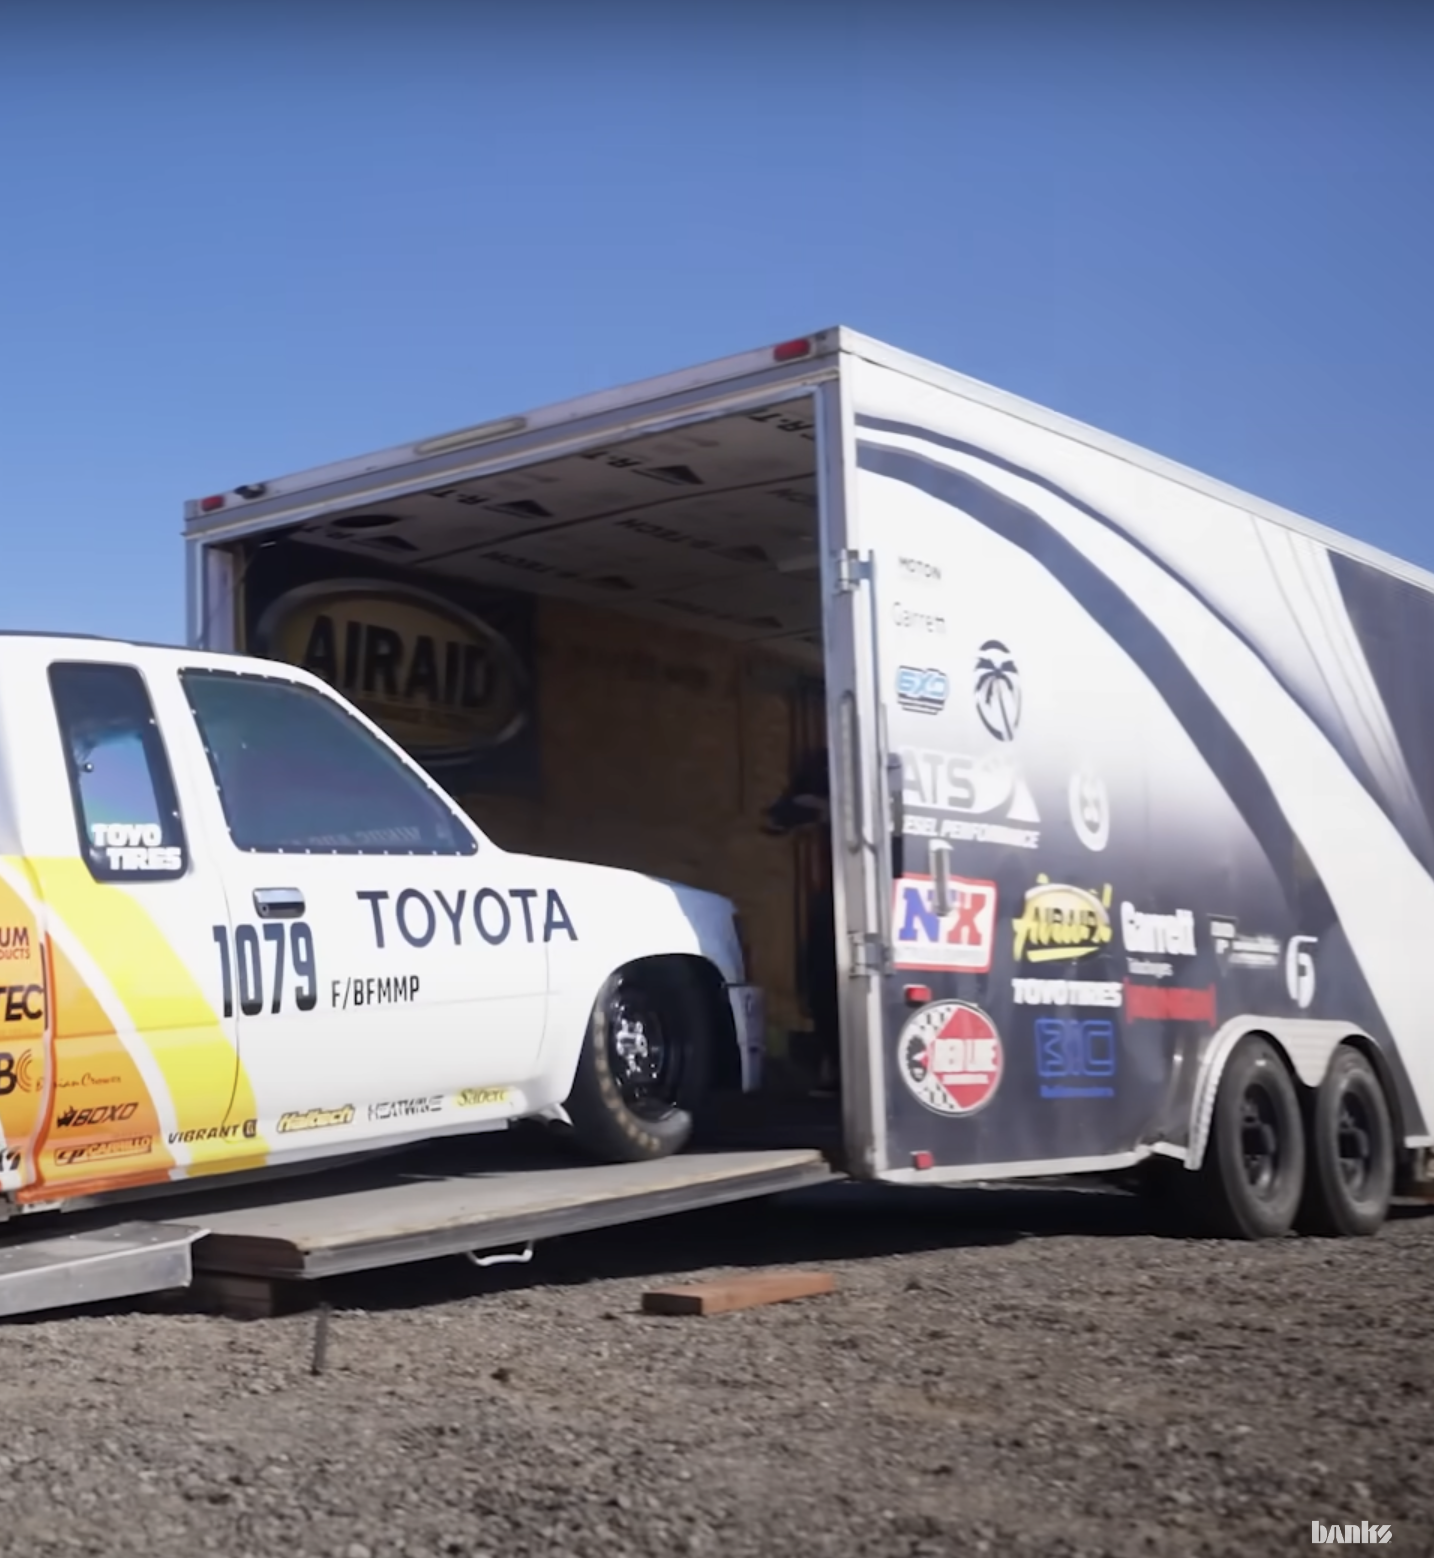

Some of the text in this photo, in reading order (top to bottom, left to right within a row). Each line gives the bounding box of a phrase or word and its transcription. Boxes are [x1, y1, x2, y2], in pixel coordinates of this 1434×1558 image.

[303, 614, 495, 709] AIRAID
[91, 822, 162, 847] TOYO
[107, 846, 182, 870] TIRES
[357, 887, 579, 949] TOYOTA
[212, 921, 318, 1018] 1079
[331, 975, 421, 1008] F/BFMMP
[71, 1102, 139, 1128] BOXO
[277, 1104, 355, 1133] Haltech
[168, 1123, 240, 1145] VIBRANT
